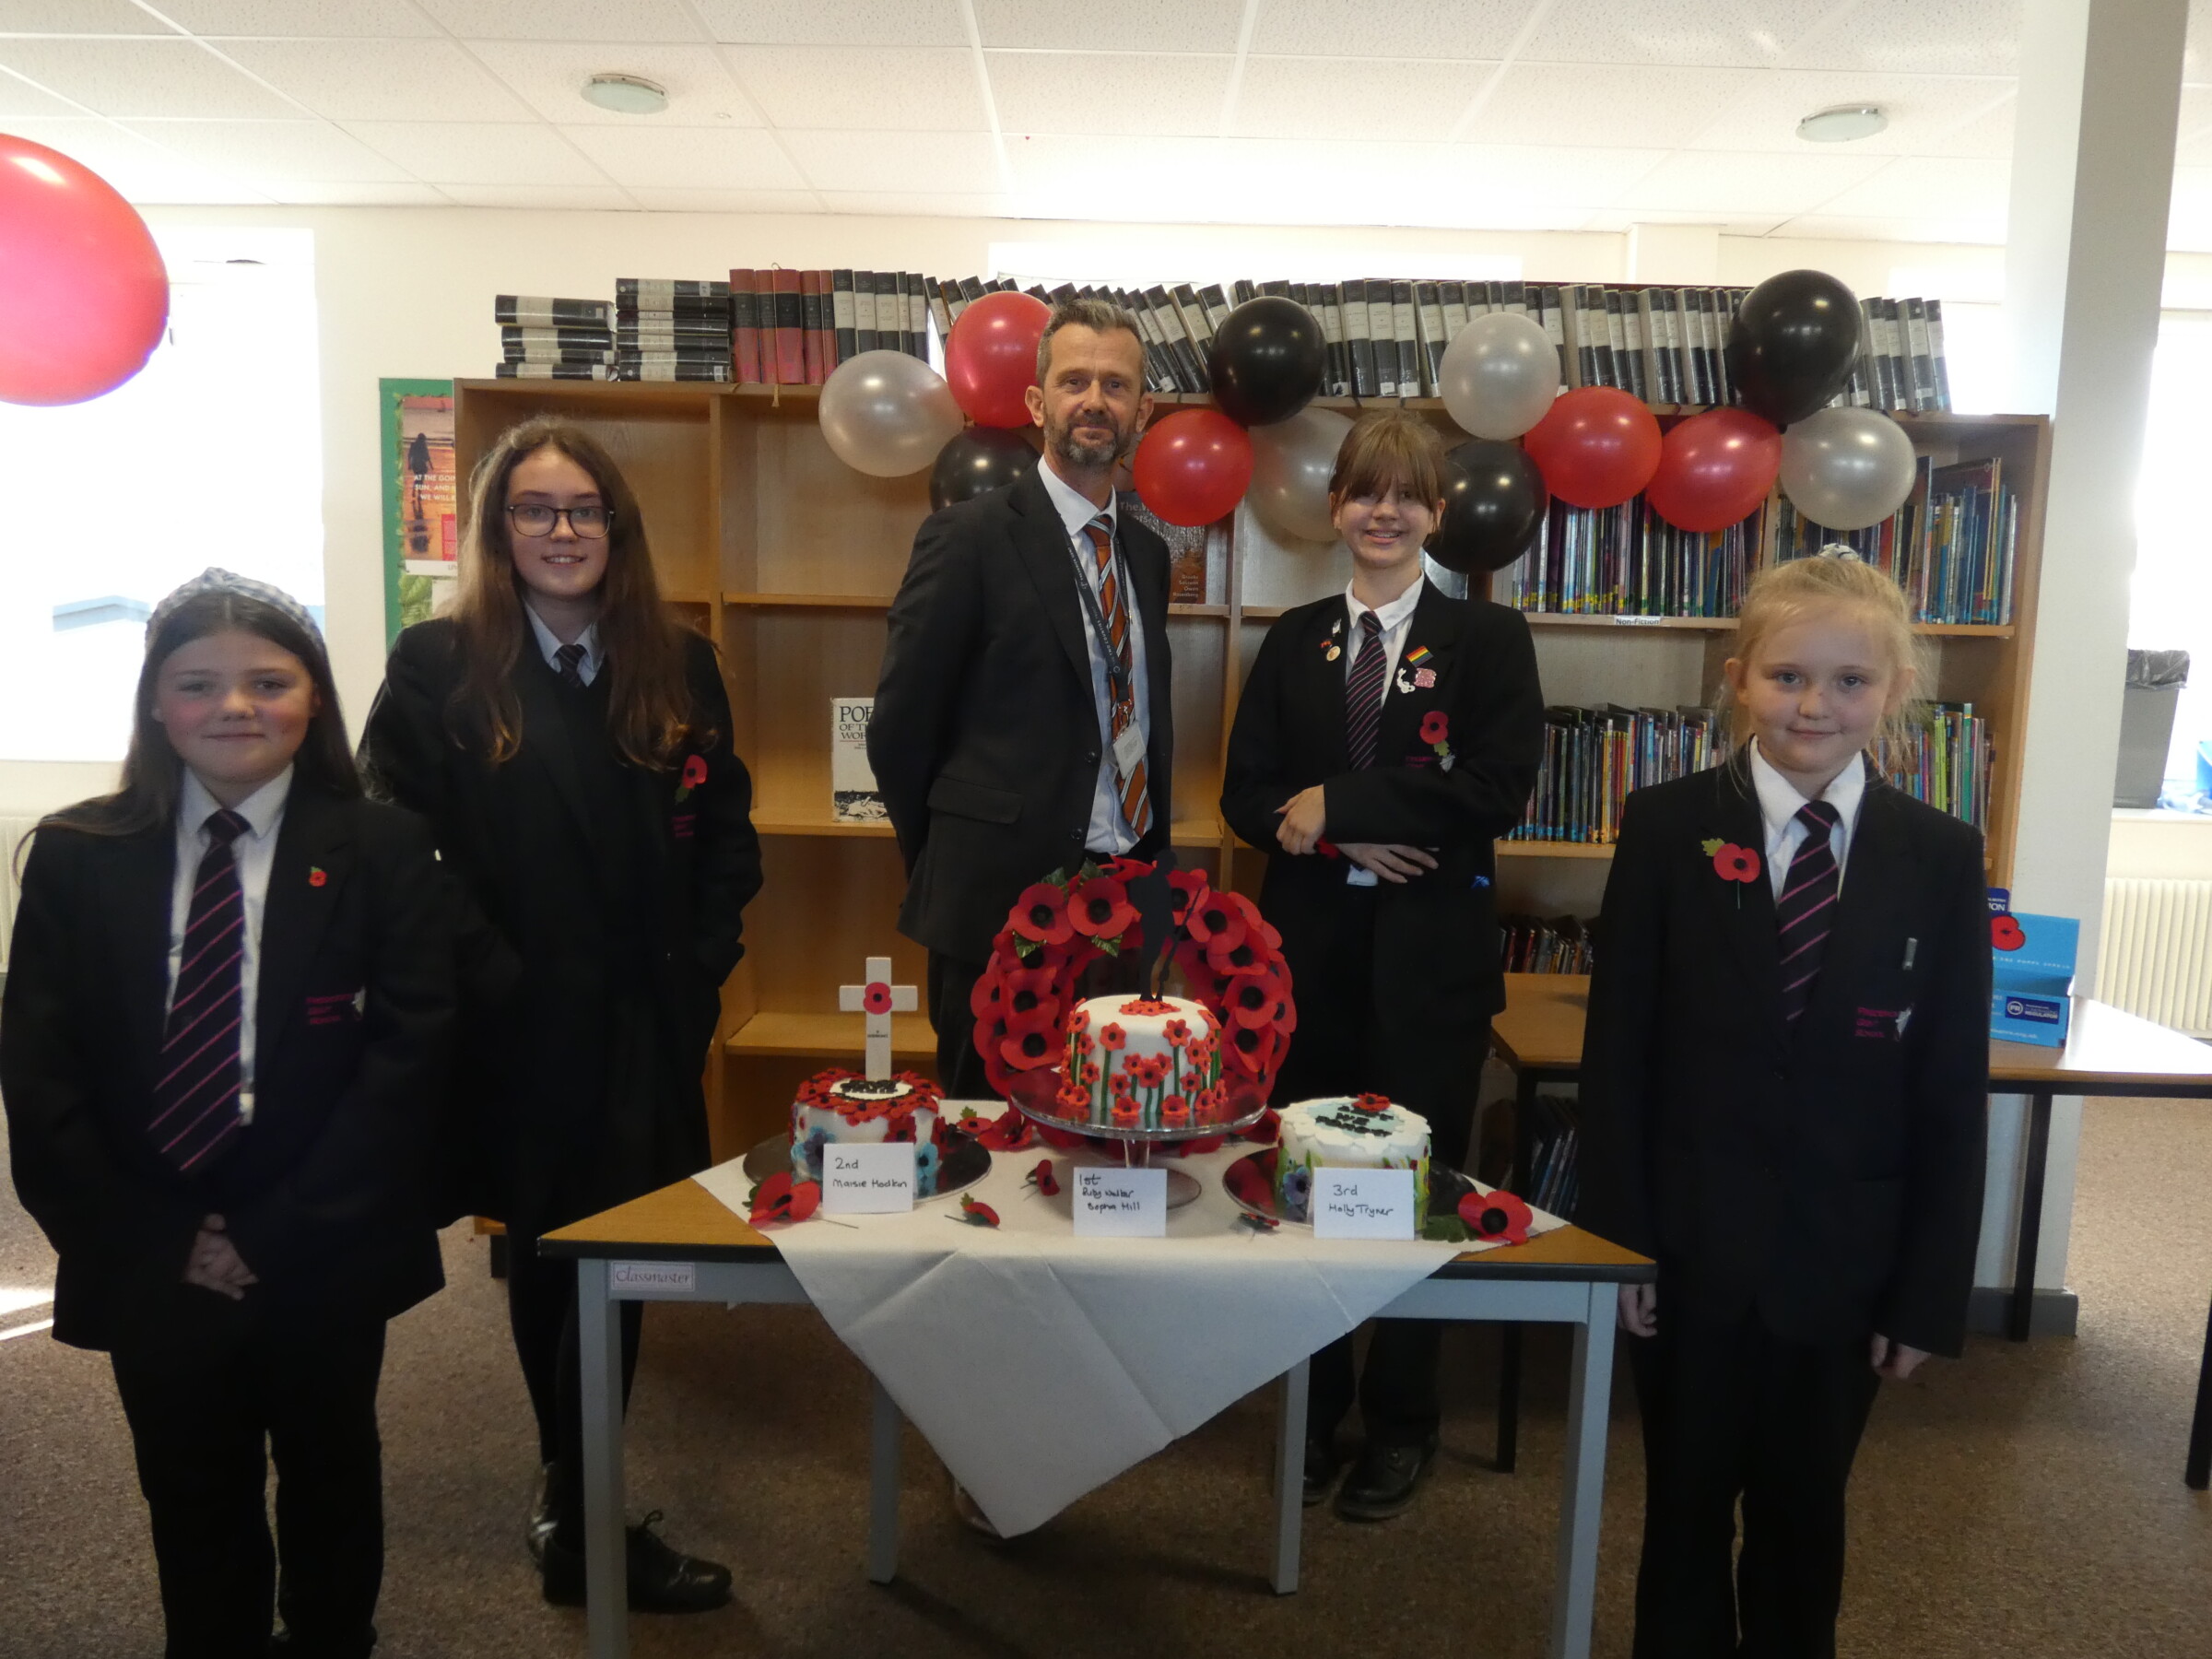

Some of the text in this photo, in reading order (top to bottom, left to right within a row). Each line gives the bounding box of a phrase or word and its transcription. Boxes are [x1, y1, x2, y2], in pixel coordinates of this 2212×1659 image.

[433, 493, 449, 501] WILL
[839, 723, 855, 732] OF
[834, 1157, 859, 1170] 2nd
[1079, 1173, 1101, 1186] 1st
[1082, 1186, 1102, 1199] Ruby
[1333, 1183, 1359, 1197] 3rd
[1121, 1201, 1141, 1212] Hill
[1328, 1203, 1355, 1218] Holly
[616, 1265, 689, 1284] Classmaster
